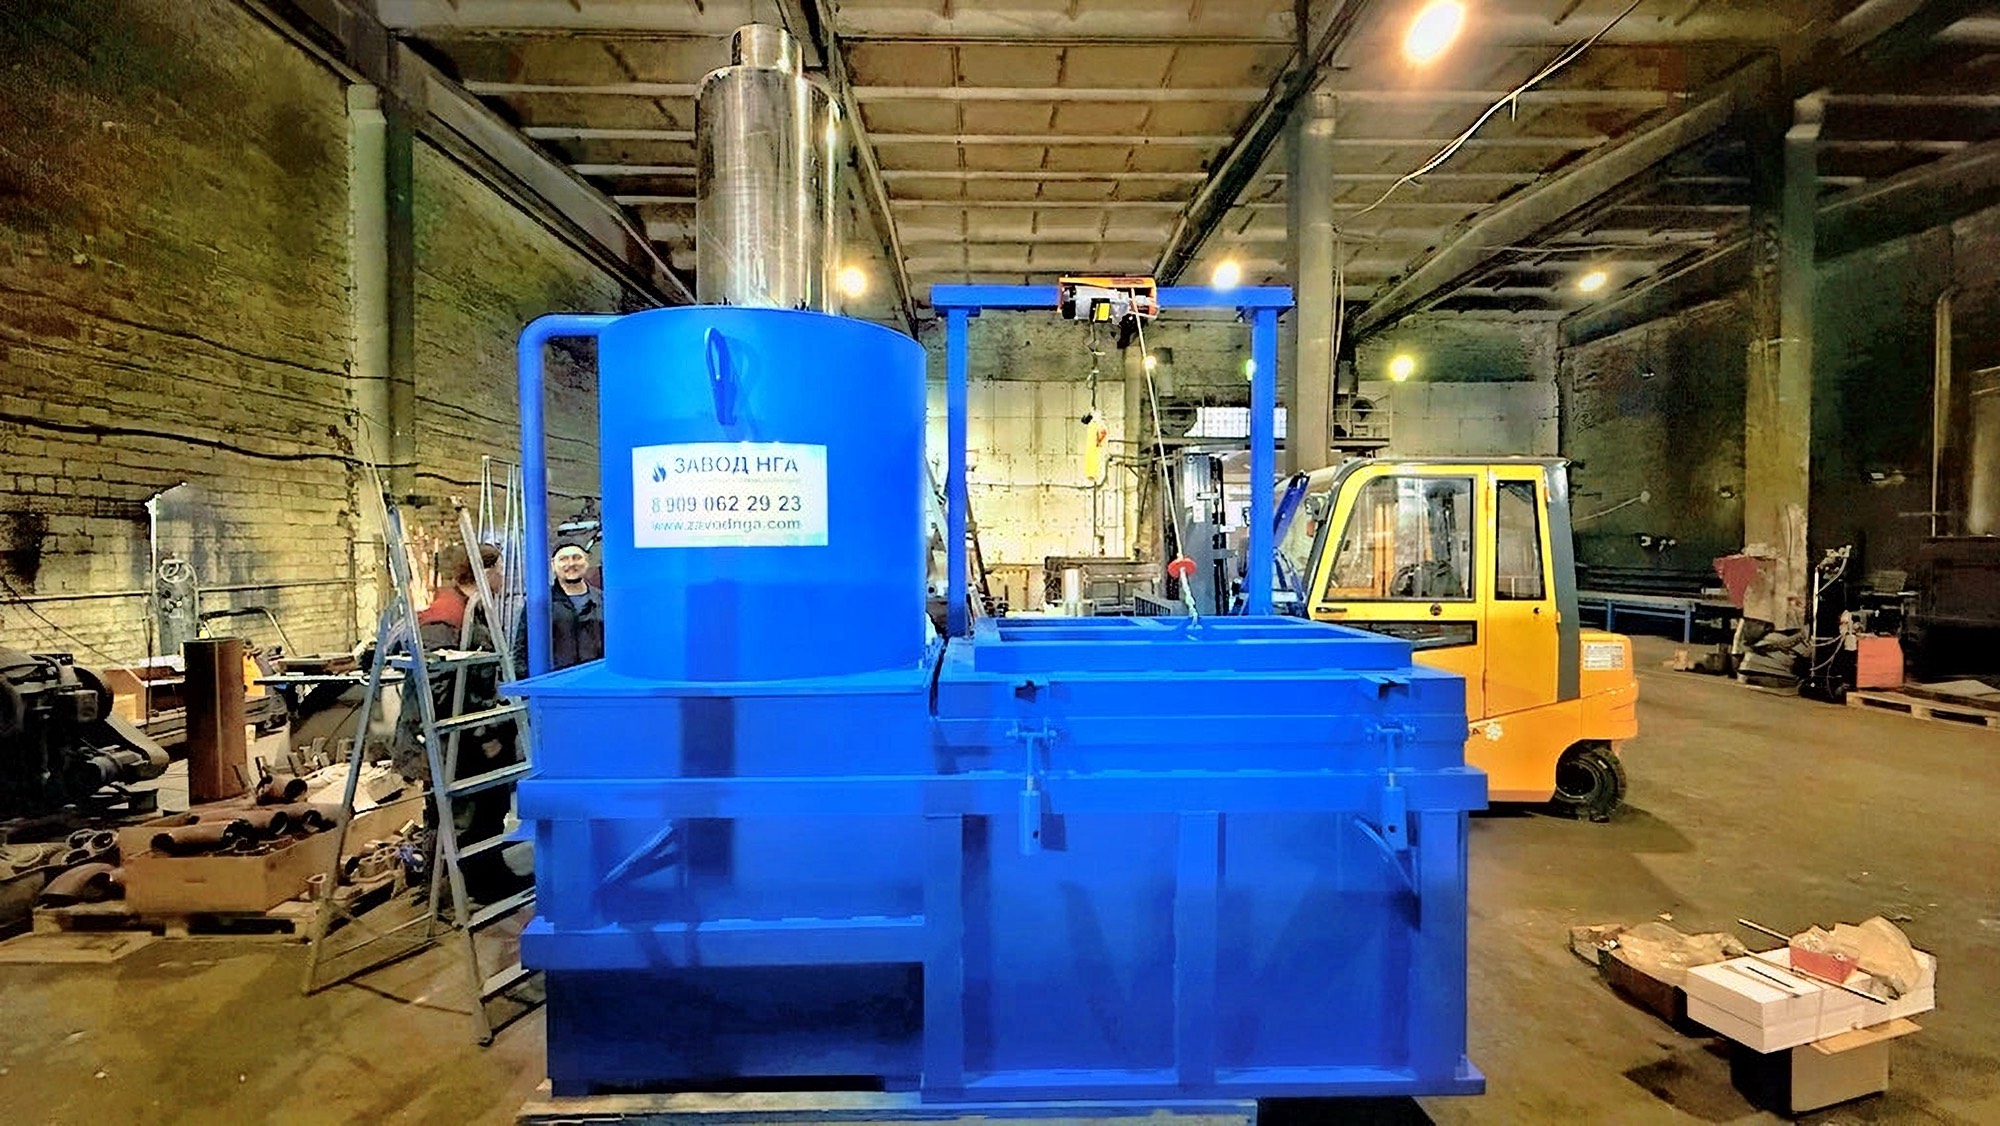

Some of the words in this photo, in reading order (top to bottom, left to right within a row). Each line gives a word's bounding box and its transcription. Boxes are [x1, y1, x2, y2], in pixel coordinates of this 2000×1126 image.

[674, 456, 749, 475] ЗАВОД
[756, 456, 798, 473] НГА
[651, 497, 661, 513] 8
[666, 496, 697, 513] 909
[704, 495, 739, 512] 062
[747, 495, 771, 512] 29
[778, 495, 801, 512] 23
[652, 518, 801, 533] www.zavodnga.com
